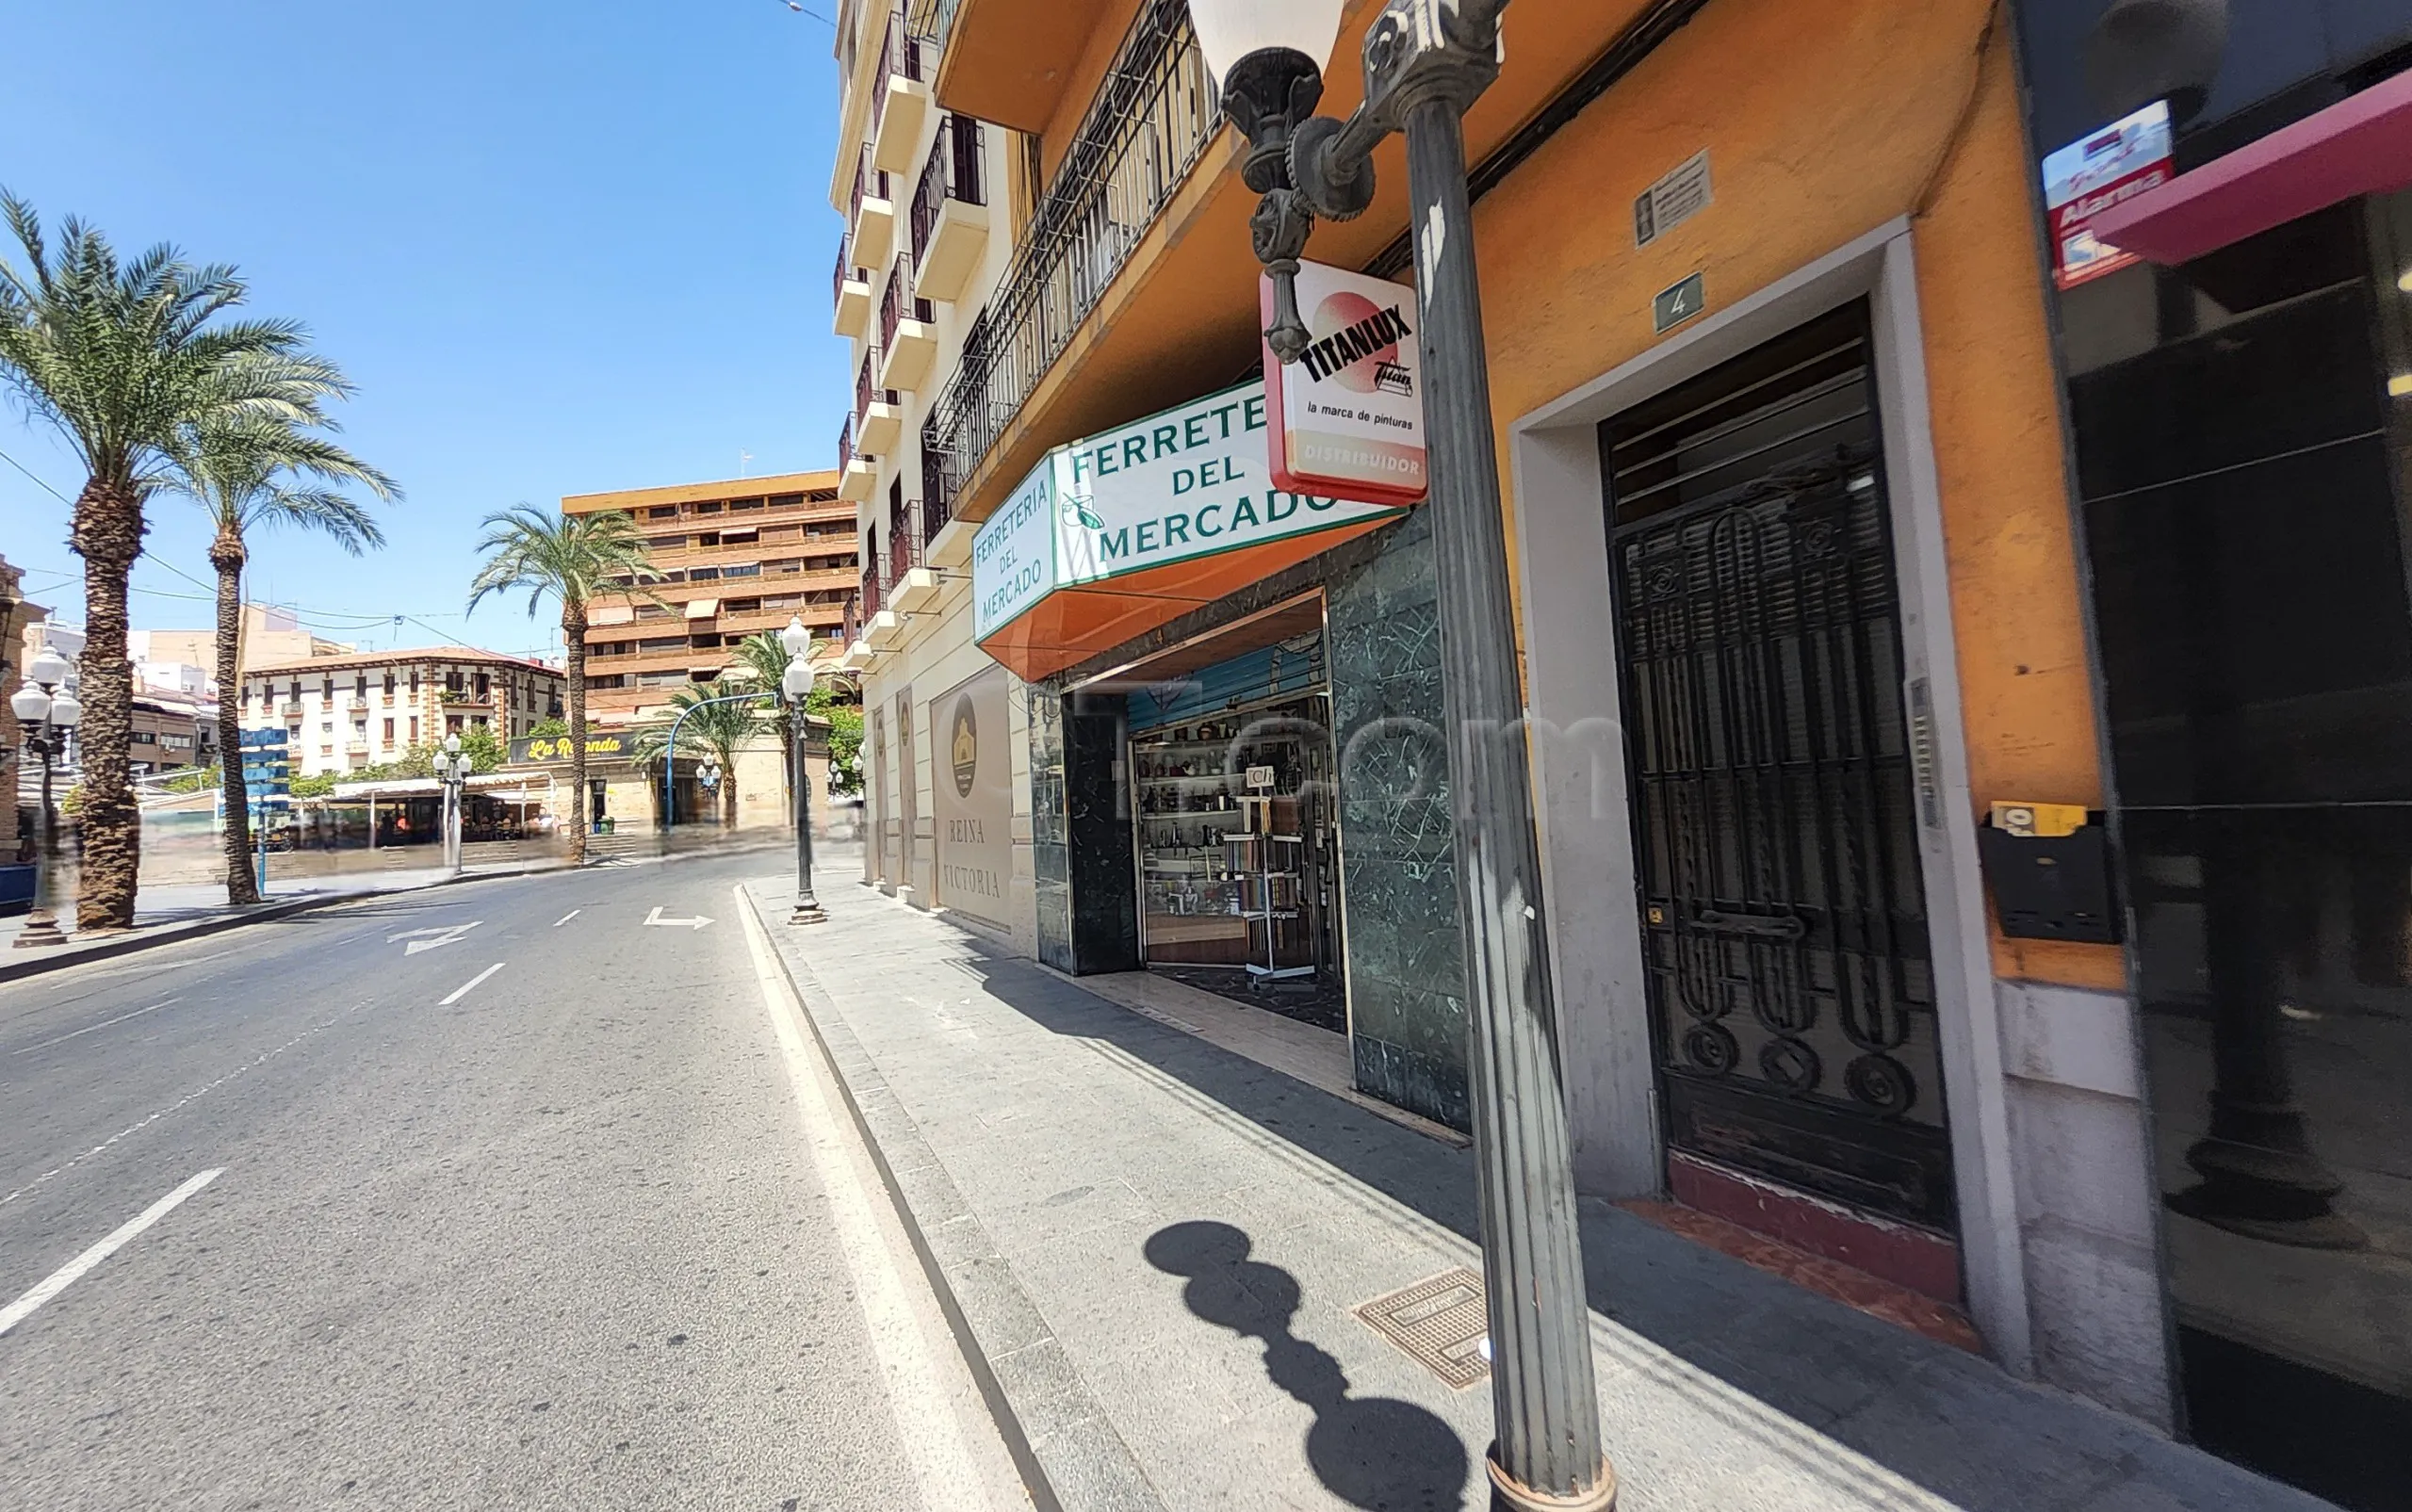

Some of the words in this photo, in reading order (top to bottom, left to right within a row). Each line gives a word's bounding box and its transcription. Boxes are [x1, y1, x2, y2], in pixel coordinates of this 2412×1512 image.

[1670, 288, 1686, 315] 4
[1299, 303, 1412, 383] TITANLUX
[1307, 401, 1317, 415] la
[1321, 405, 1353, 420] marca
[1358, 409, 1370, 422] de
[1374, 414, 1413, 431] pinturas
[1071, 394, 1267, 485] FERRETE
[1172, 455, 1245, 496] DEL
[1304, 443, 1420, 475] DISTRIBUIDOR
[976, 479, 1047, 568] FERRETERIA
[999, 545, 1019, 576] DEL
[983, 559, 1042, 623] MERCADO
[528, 740, 555, 760] La
[949, 819, 985, 843] REINA
[943, 864, 1000, 899] VICTORIA
